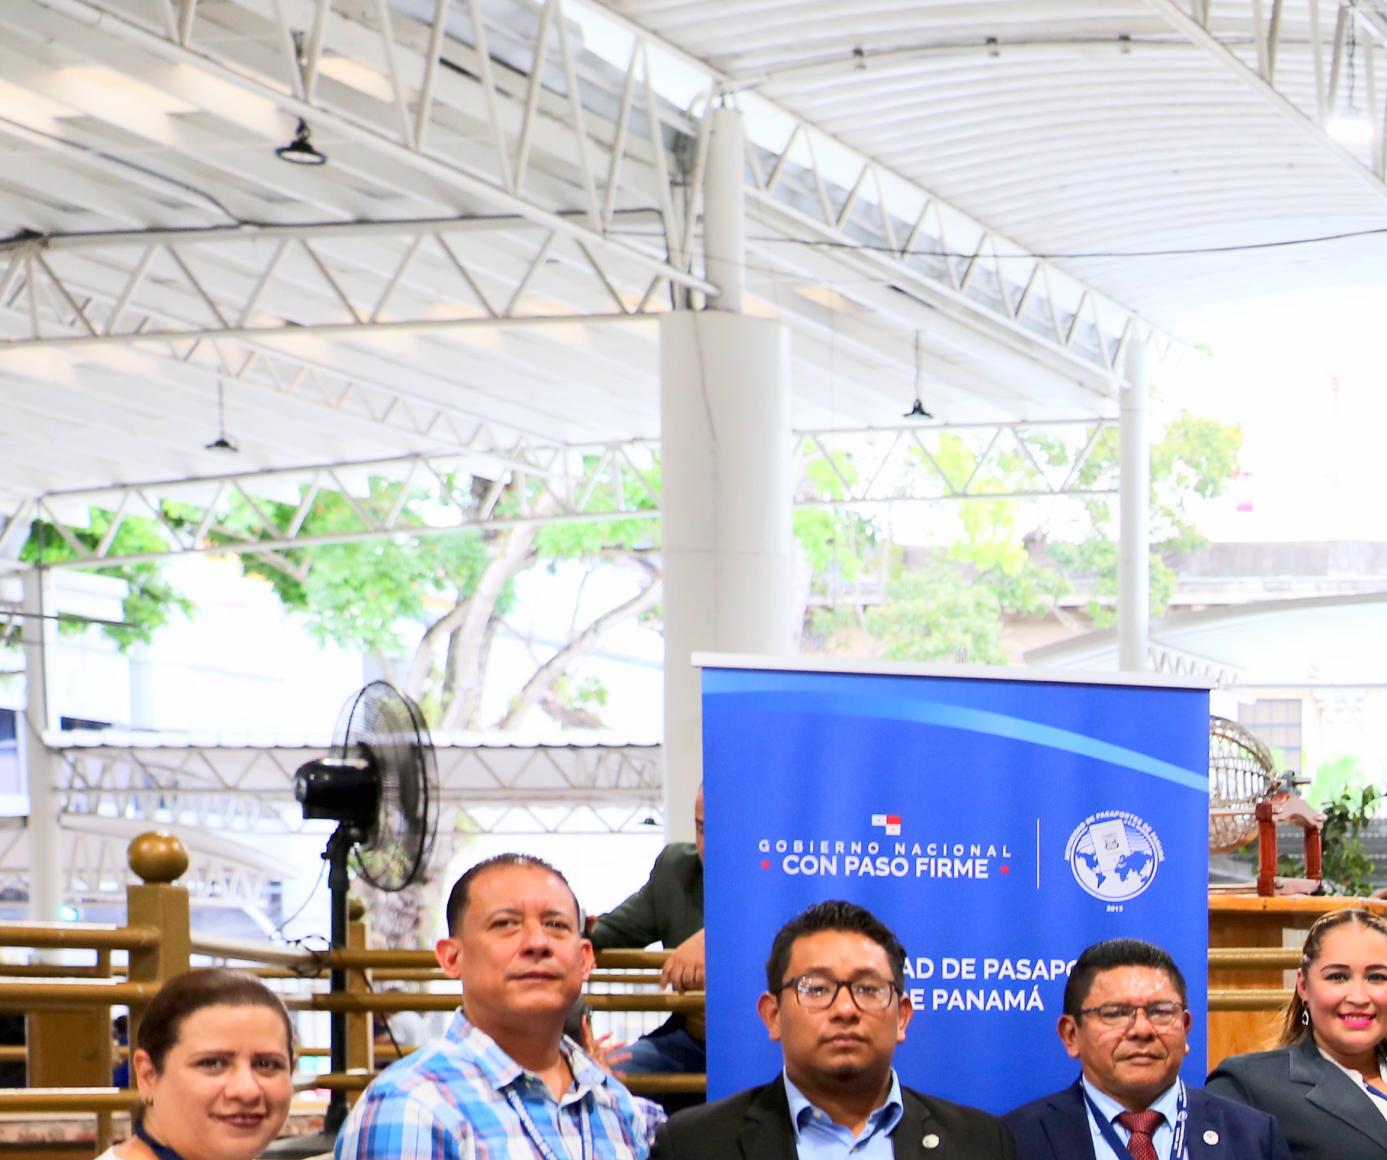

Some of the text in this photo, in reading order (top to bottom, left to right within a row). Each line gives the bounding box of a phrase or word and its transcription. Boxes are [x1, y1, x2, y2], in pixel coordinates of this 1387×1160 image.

[759, 839, 1011, 857] GOBIERNO NACIONAL
[783, 855, 988, 878] CON PASO FIRME
[942, 958, 976, 979] DE
[933, 985, 1044, 1011] PANAMÁ
